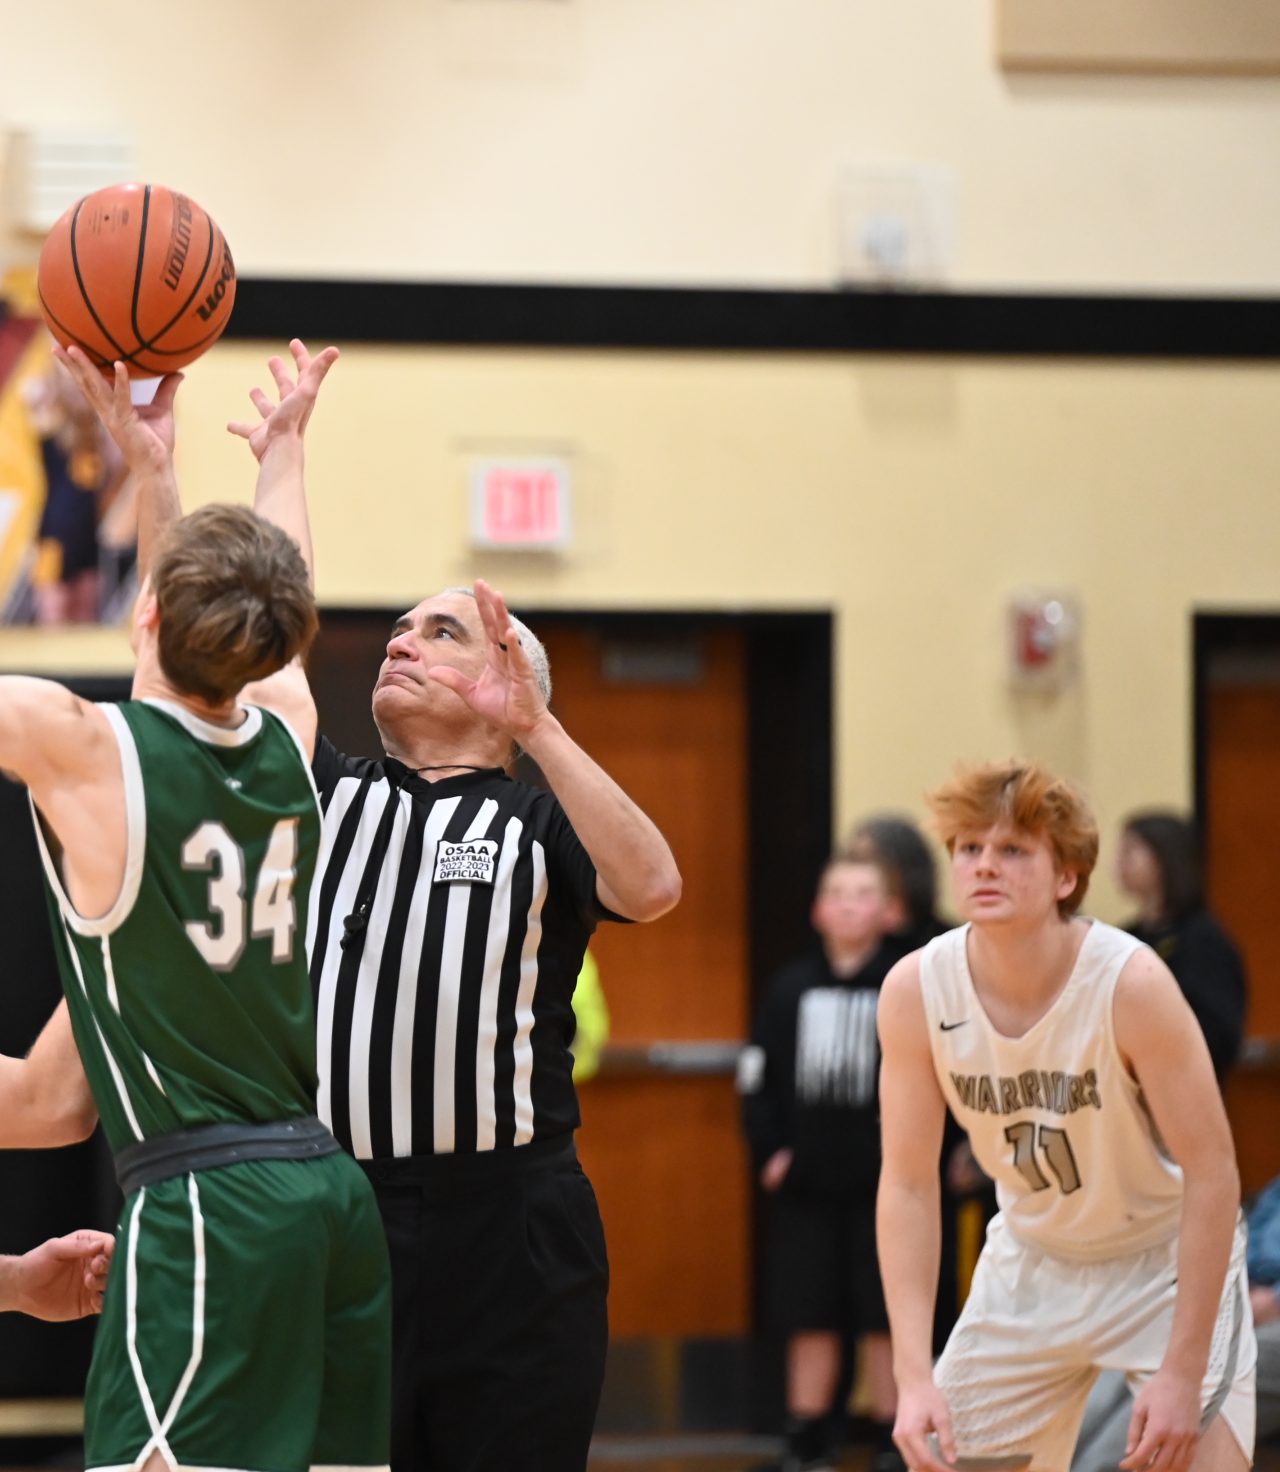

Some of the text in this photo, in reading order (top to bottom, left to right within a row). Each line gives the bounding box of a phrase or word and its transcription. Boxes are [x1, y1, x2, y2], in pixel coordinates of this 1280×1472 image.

[445, 845, 490, 856] OSAA
[439, 855, 491, 864] BASKETBALL
[440, 861, 490, 871] 2022-2023
[439, 870, 486, 880] OFFICIAL
[182, 816, 300, 971] 34
[950, 1069, 1102, 1115] WARRIORS
[1004, 1121, 1082, 1195] 11
